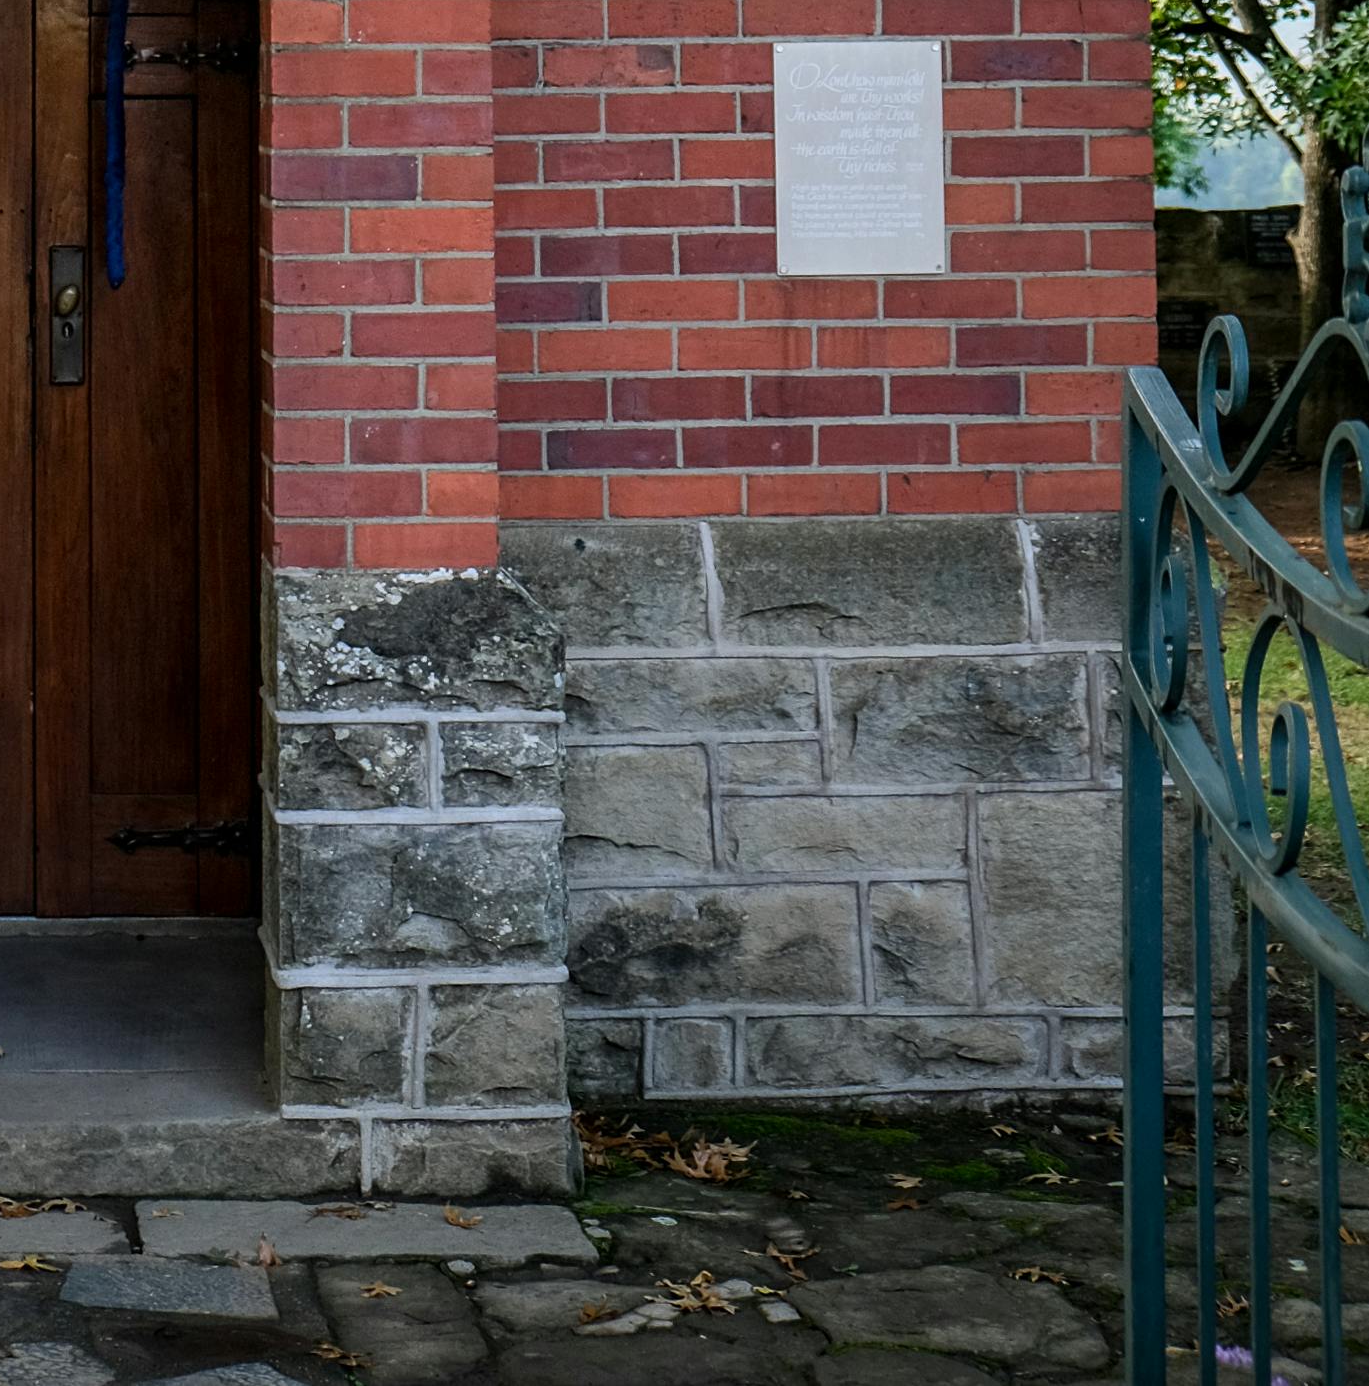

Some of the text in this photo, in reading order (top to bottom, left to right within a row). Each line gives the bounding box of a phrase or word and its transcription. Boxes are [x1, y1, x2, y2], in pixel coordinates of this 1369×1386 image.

[840, 92, 857, 103] are
[786, 104, 915, 122] In wisdom hast Thou
[840, 123, 873, 139] made
[875, 124, 903, 139] them
[817, 141, 847, 155] earth
[848, 143, 860, 155] is
[860, 139, 882, 155] full
[882, 139, 898, 154] of
